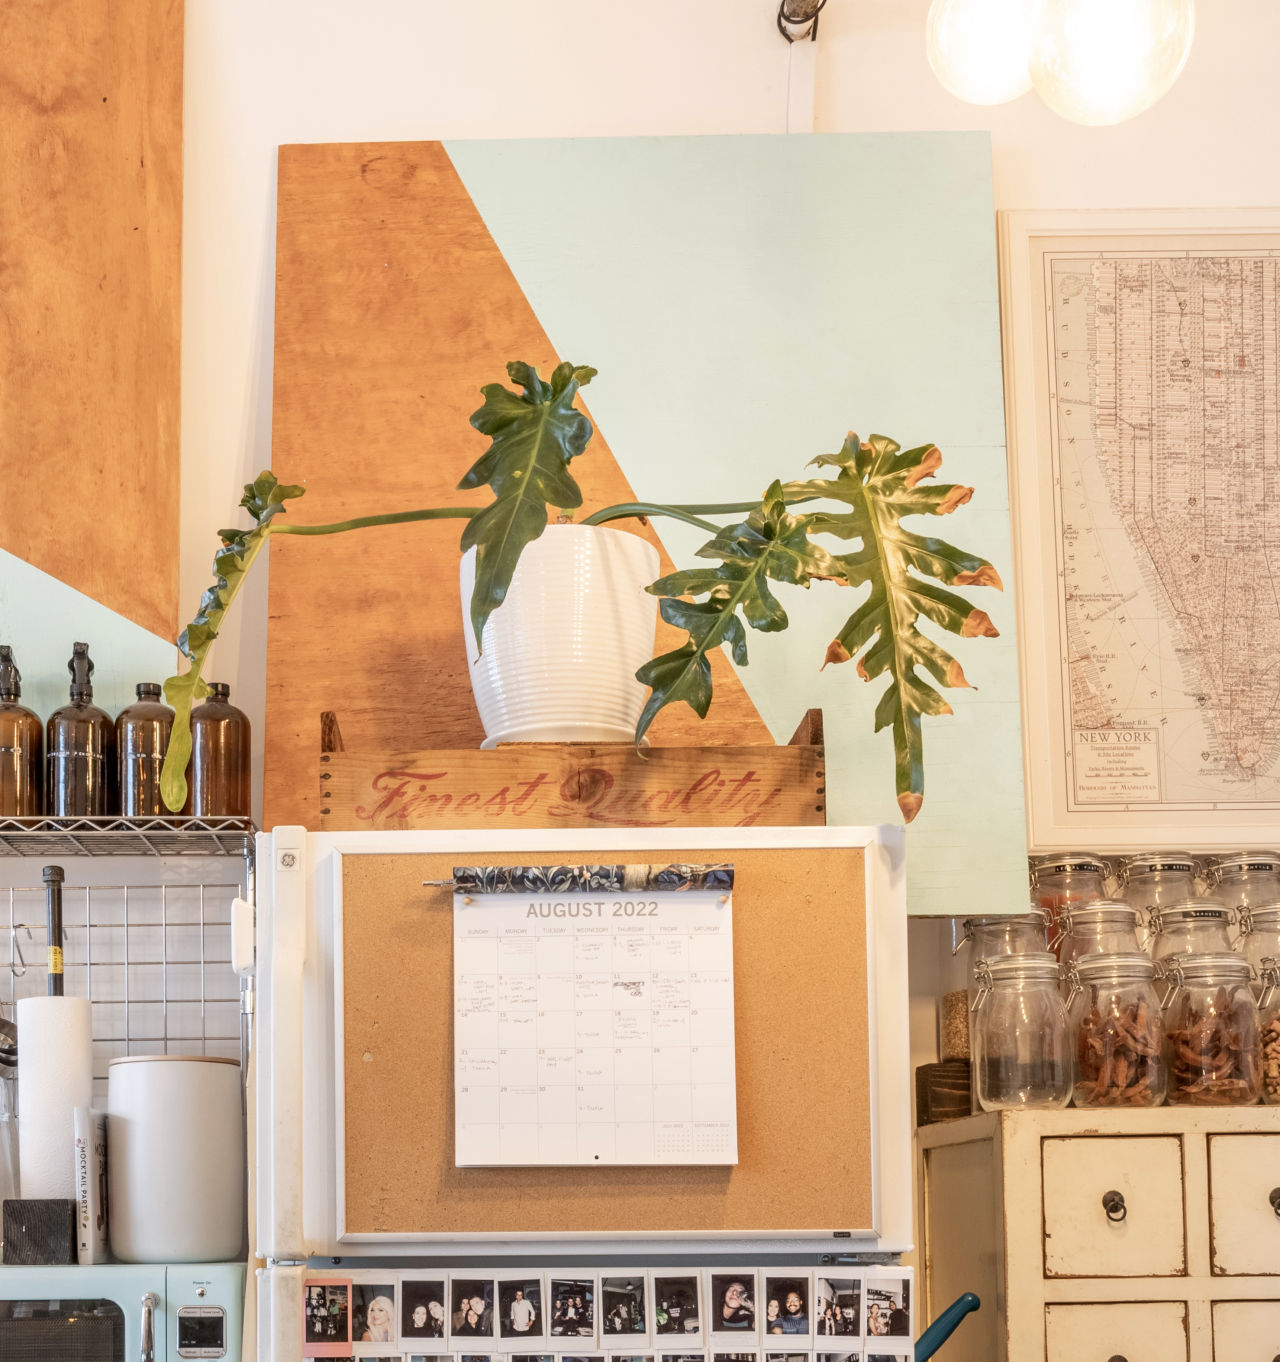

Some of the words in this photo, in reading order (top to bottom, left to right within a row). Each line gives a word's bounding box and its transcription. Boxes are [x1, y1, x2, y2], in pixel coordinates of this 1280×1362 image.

[1079, 732, 1111, 743] NEW
[1114, 731, 1152, 743] YORK
[355, 769, 559, 822] Finest
[547, 766, 784, 827] Quality
[527, 902, 605, 918] AUGUST
[612, 901, 659, 917] 2022
[80, 1146, 88, 1188] MOCKTAIL
